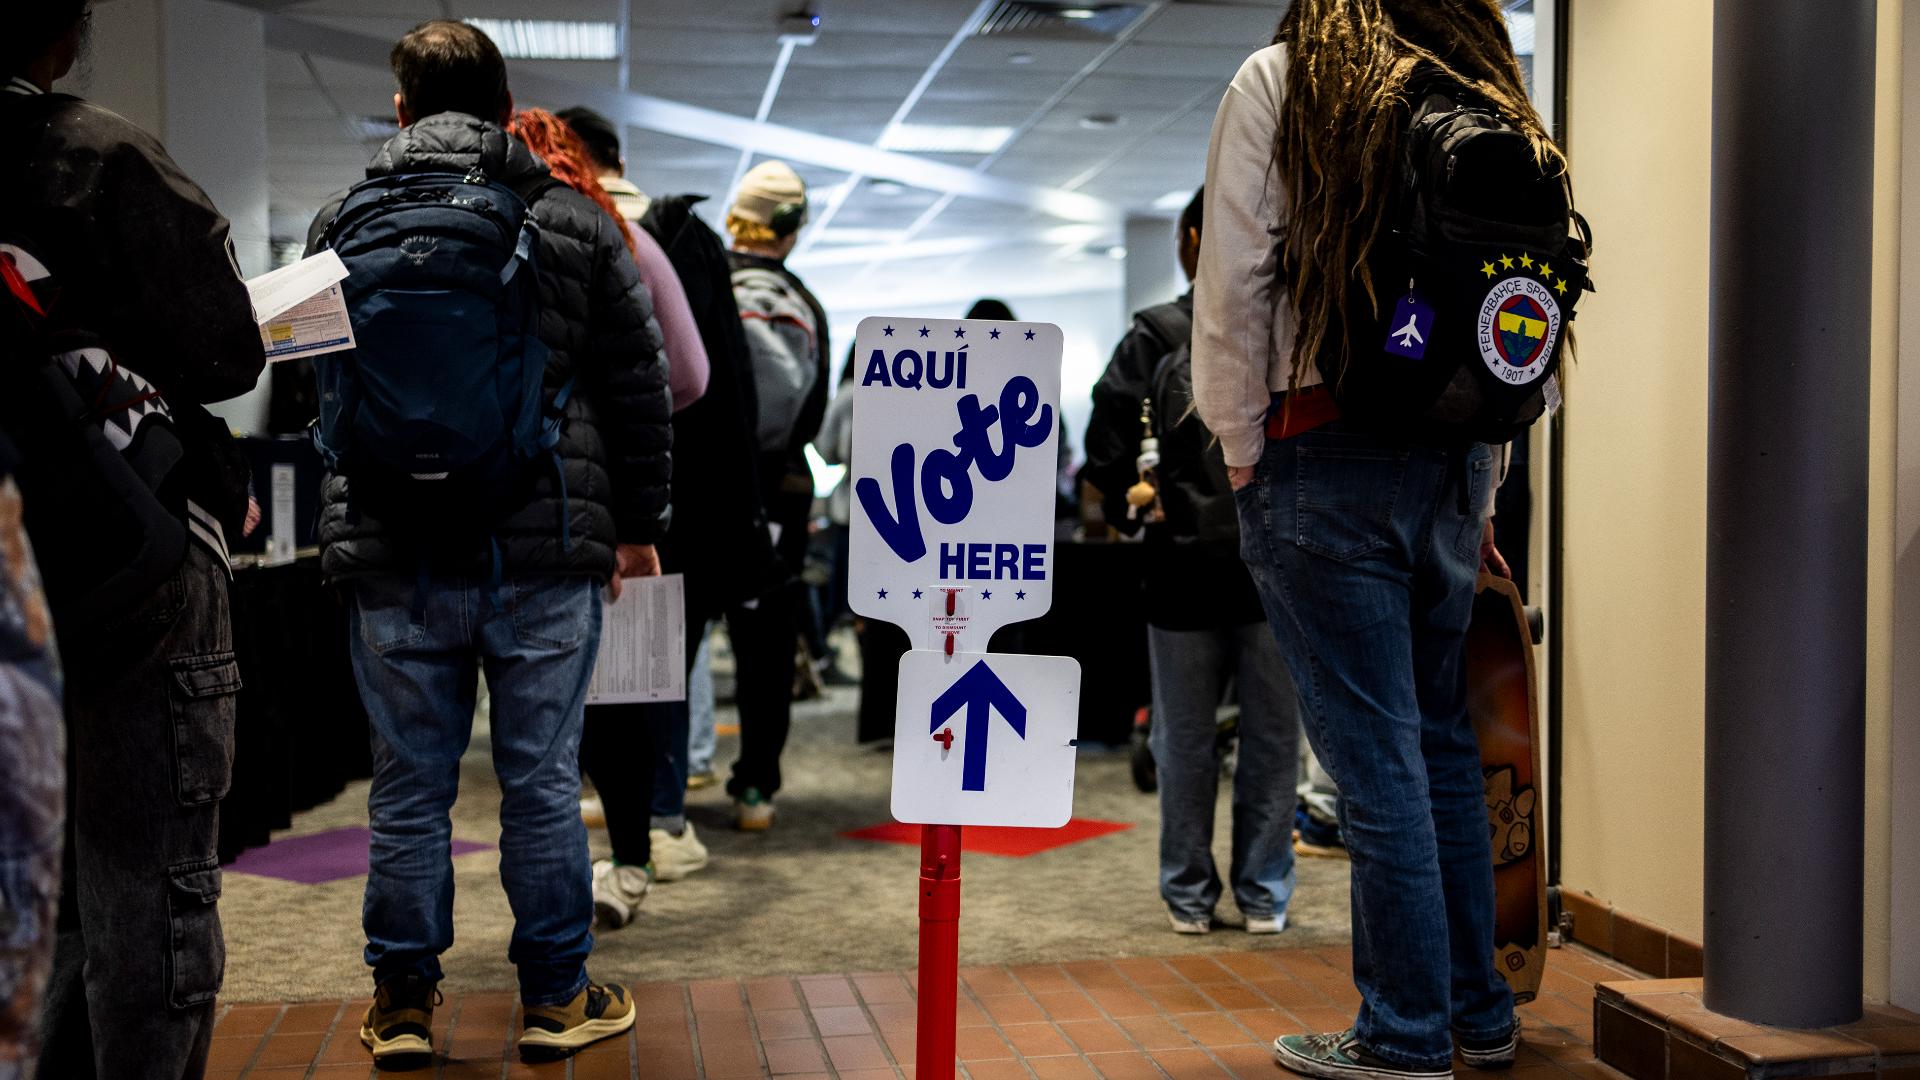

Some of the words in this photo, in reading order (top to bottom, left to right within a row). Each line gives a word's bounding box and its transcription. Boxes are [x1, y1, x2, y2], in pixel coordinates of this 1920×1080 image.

[401, 234, 439, 246] OSPREY
[1479, 280, 1522, 353] FENERBAHÇE
[1526, 281, 1553, 310] SPOR
[861, 343, 969, 391] AQUÍ
[1501, 366, 1524, 381] 1907
[855, 375, 1053, 563] Vote
[939, 542, 1047, 581] HERE
